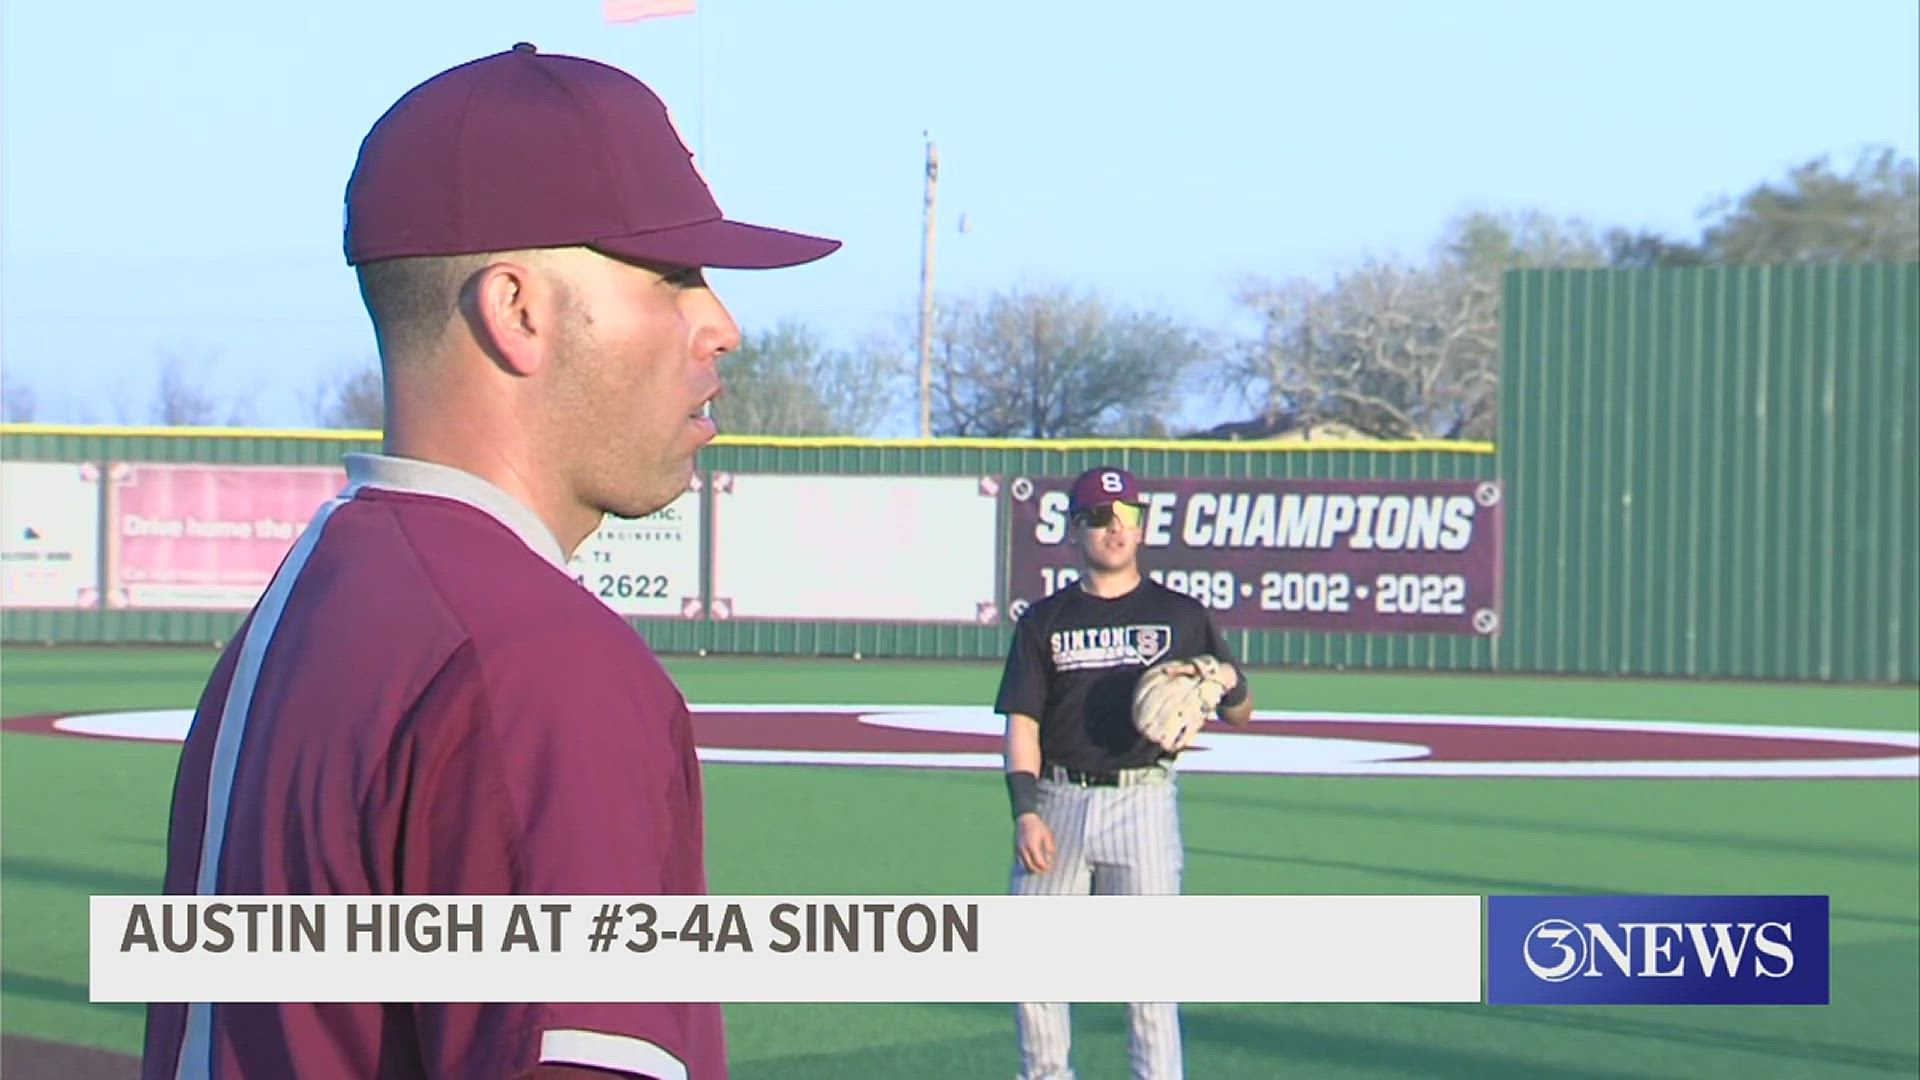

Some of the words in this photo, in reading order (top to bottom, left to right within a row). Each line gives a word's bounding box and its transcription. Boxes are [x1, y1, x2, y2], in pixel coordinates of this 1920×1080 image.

[122, 514, 184, 537] Drive
[185, 515, 253, 538] home
[255, 517, 293, 540] the
[1183, 494, 1475, 550] CHAMPIONS
[1261, 572, 1350, 612] 2002
[1375, 575, 1466, 614] 2022
[1051, 626, 1125, 653] SINTON
